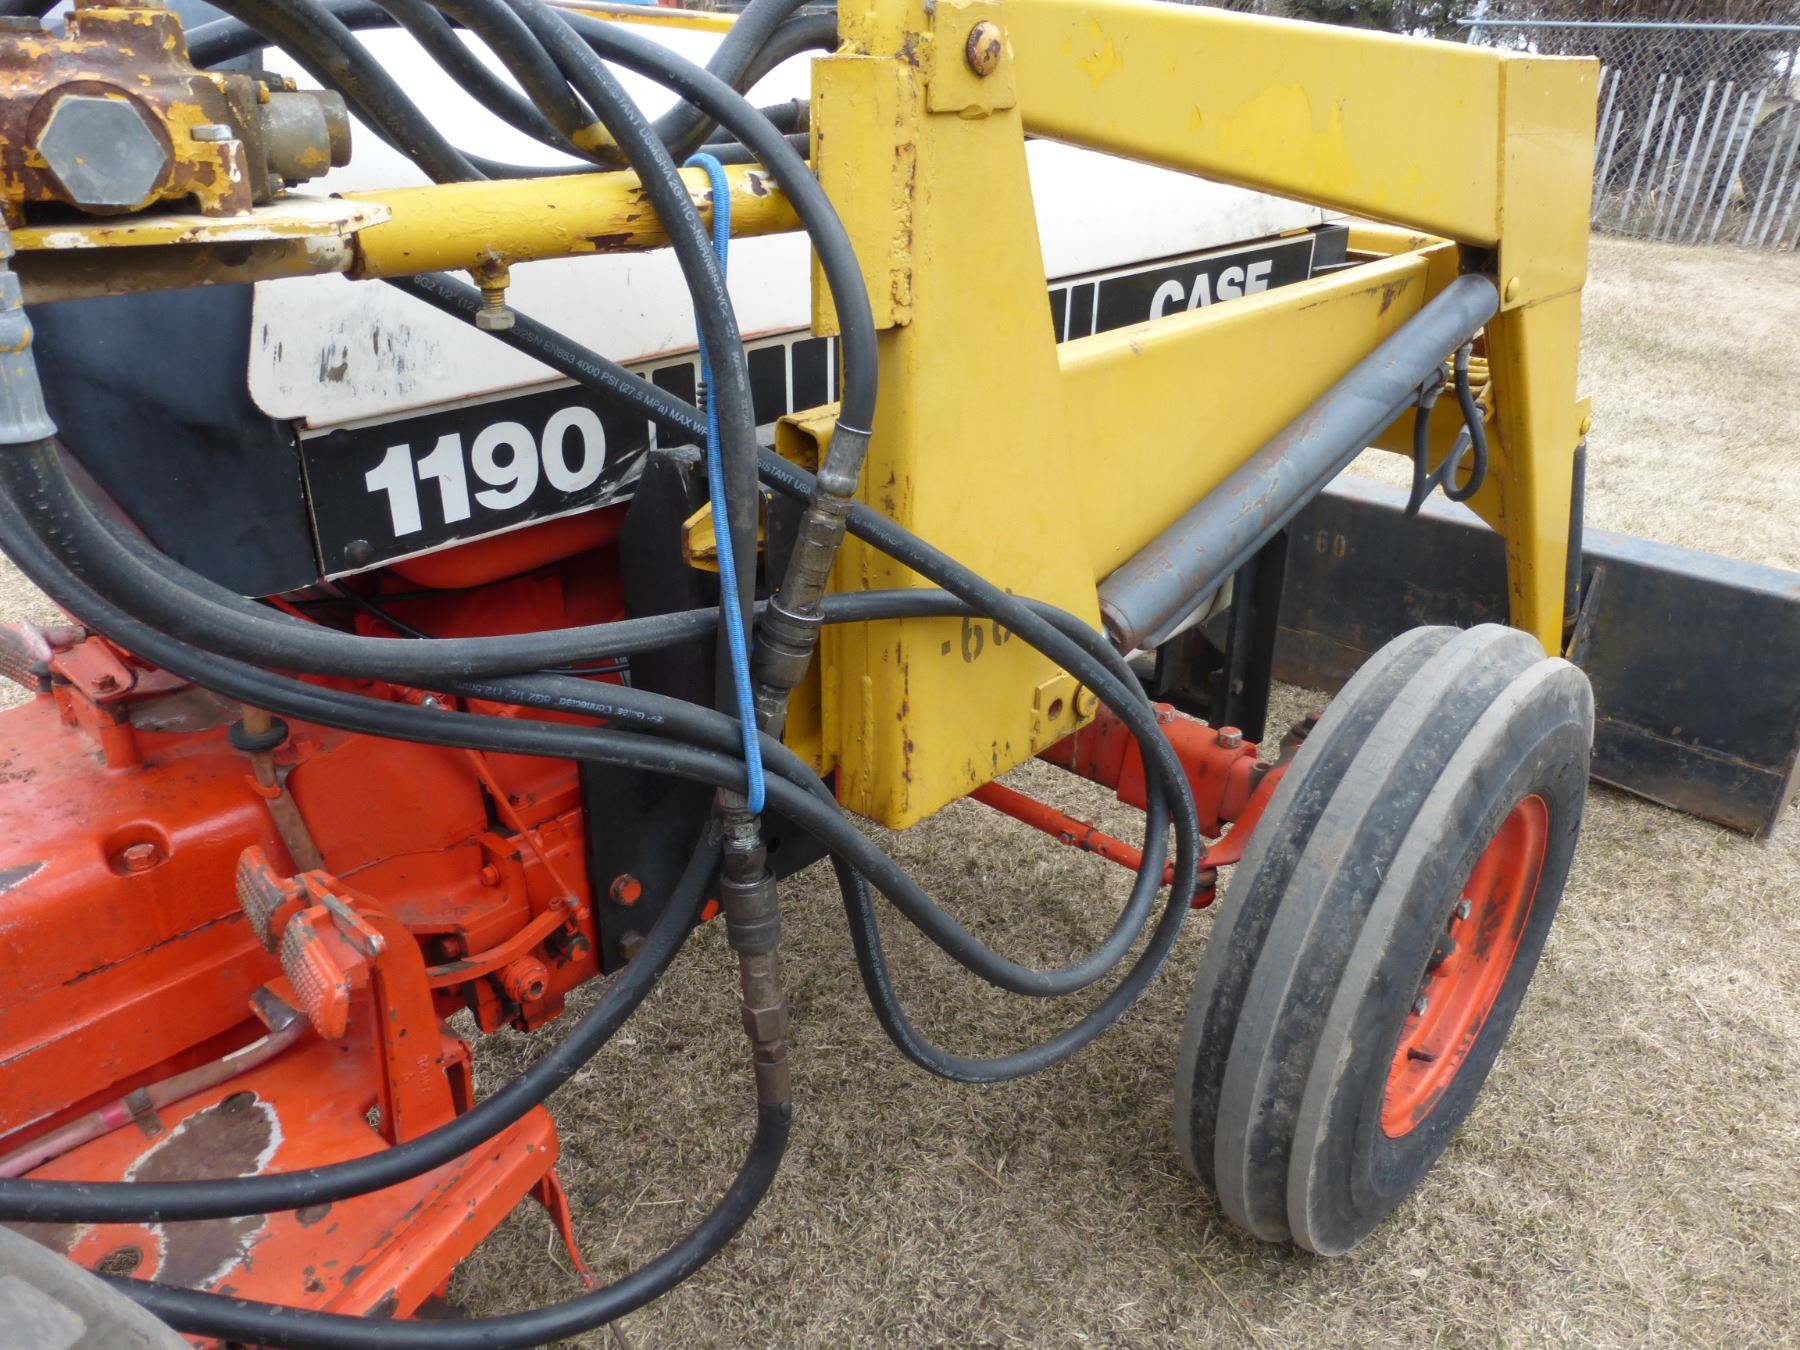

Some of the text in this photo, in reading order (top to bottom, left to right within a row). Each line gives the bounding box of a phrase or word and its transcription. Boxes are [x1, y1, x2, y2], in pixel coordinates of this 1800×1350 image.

[1148, 259, 1273, 321] CASE
[575, 358, 601, 378] 4000
[600, 371, 618, 388] PSI
[669, 408, 694, 428] MAX
[365, 406, 606, 537] 1190
